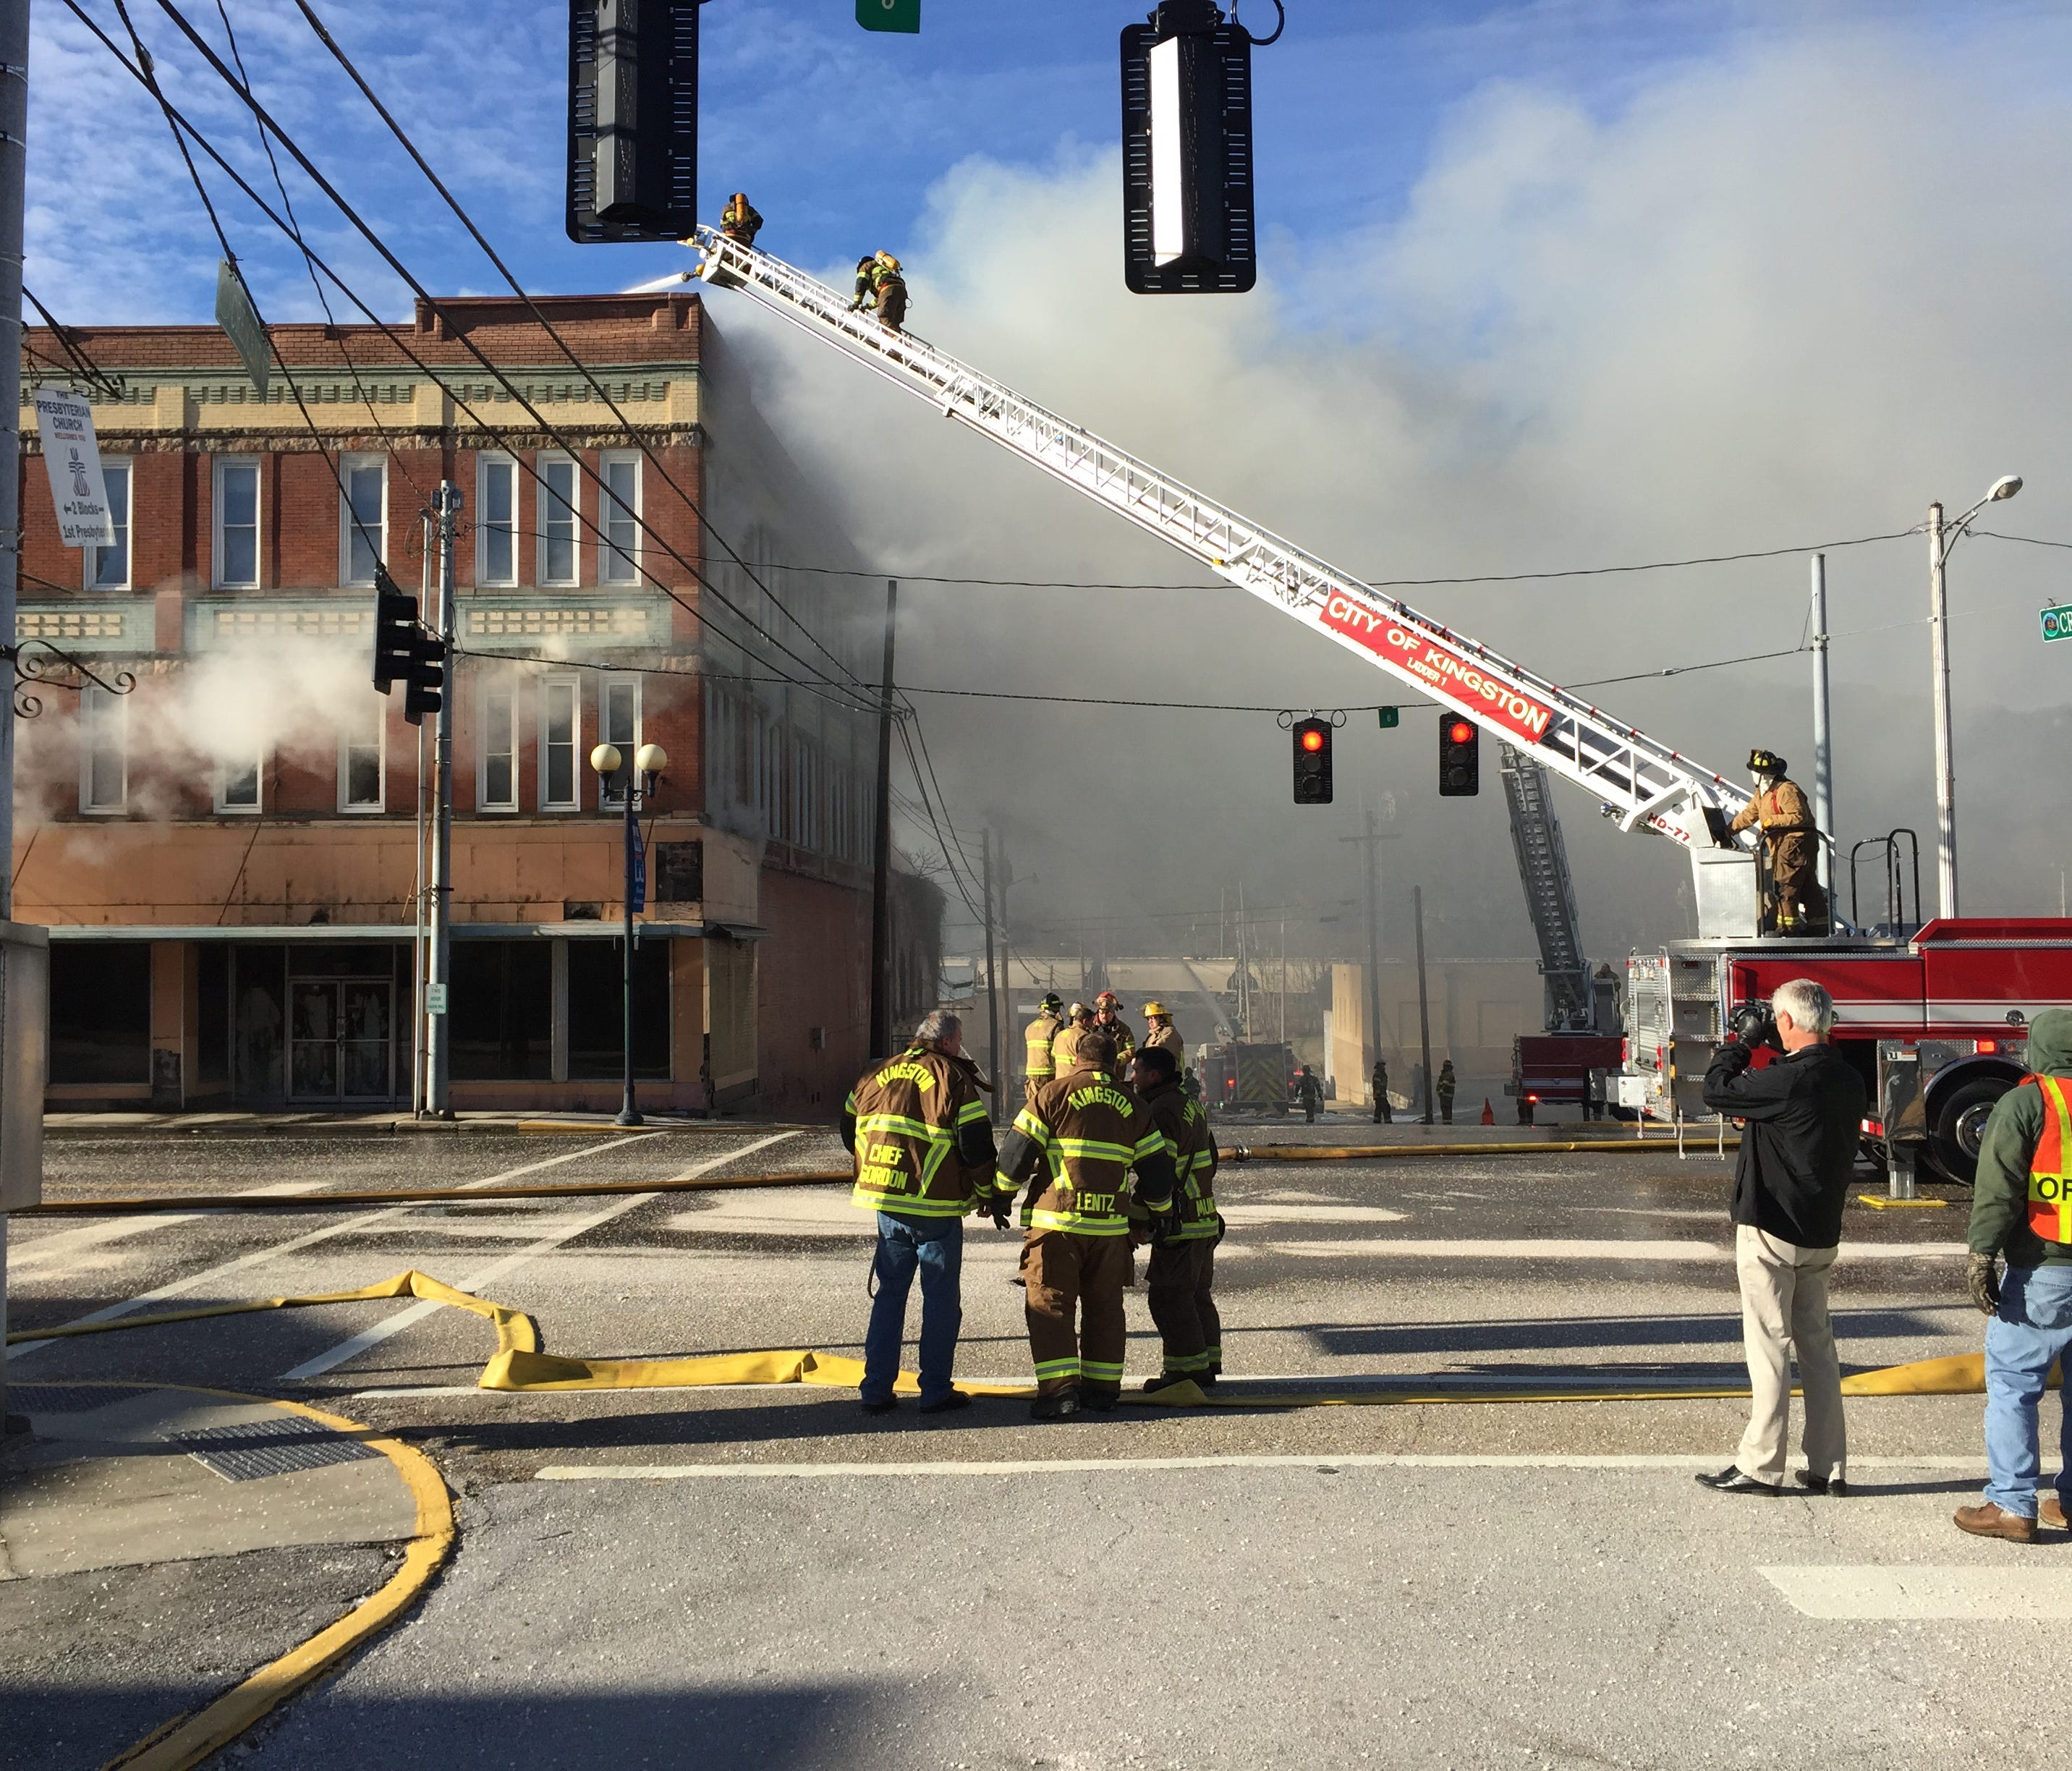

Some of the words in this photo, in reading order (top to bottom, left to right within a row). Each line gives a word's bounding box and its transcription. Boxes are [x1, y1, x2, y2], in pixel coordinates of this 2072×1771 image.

[36, 400, 91, 418] PRESBYTERIAN
[53, 417, 83, 431] CHURCH
[72, 501, 77, 515] 2
[77, 501, 99, 515] Blocks
[1328, 597, 1383, 633] CITY
[1387, 628, 1422, 651] OF
[1424, 648, 1548, 734] KINGSTON
[1406, 657, 1441, 683] LADDER
[1440, 676, 1448, 687] 1
[875, 1062, 936, 1093] KINGSTON
[1067, 1086, 1134, 1118] KINGSTON
[869, 1143, 905, 1165] CHIEF
[859, 1164, 909, 1189] GORDON
[1077, 1192, 1115, 1212] LENTZ
